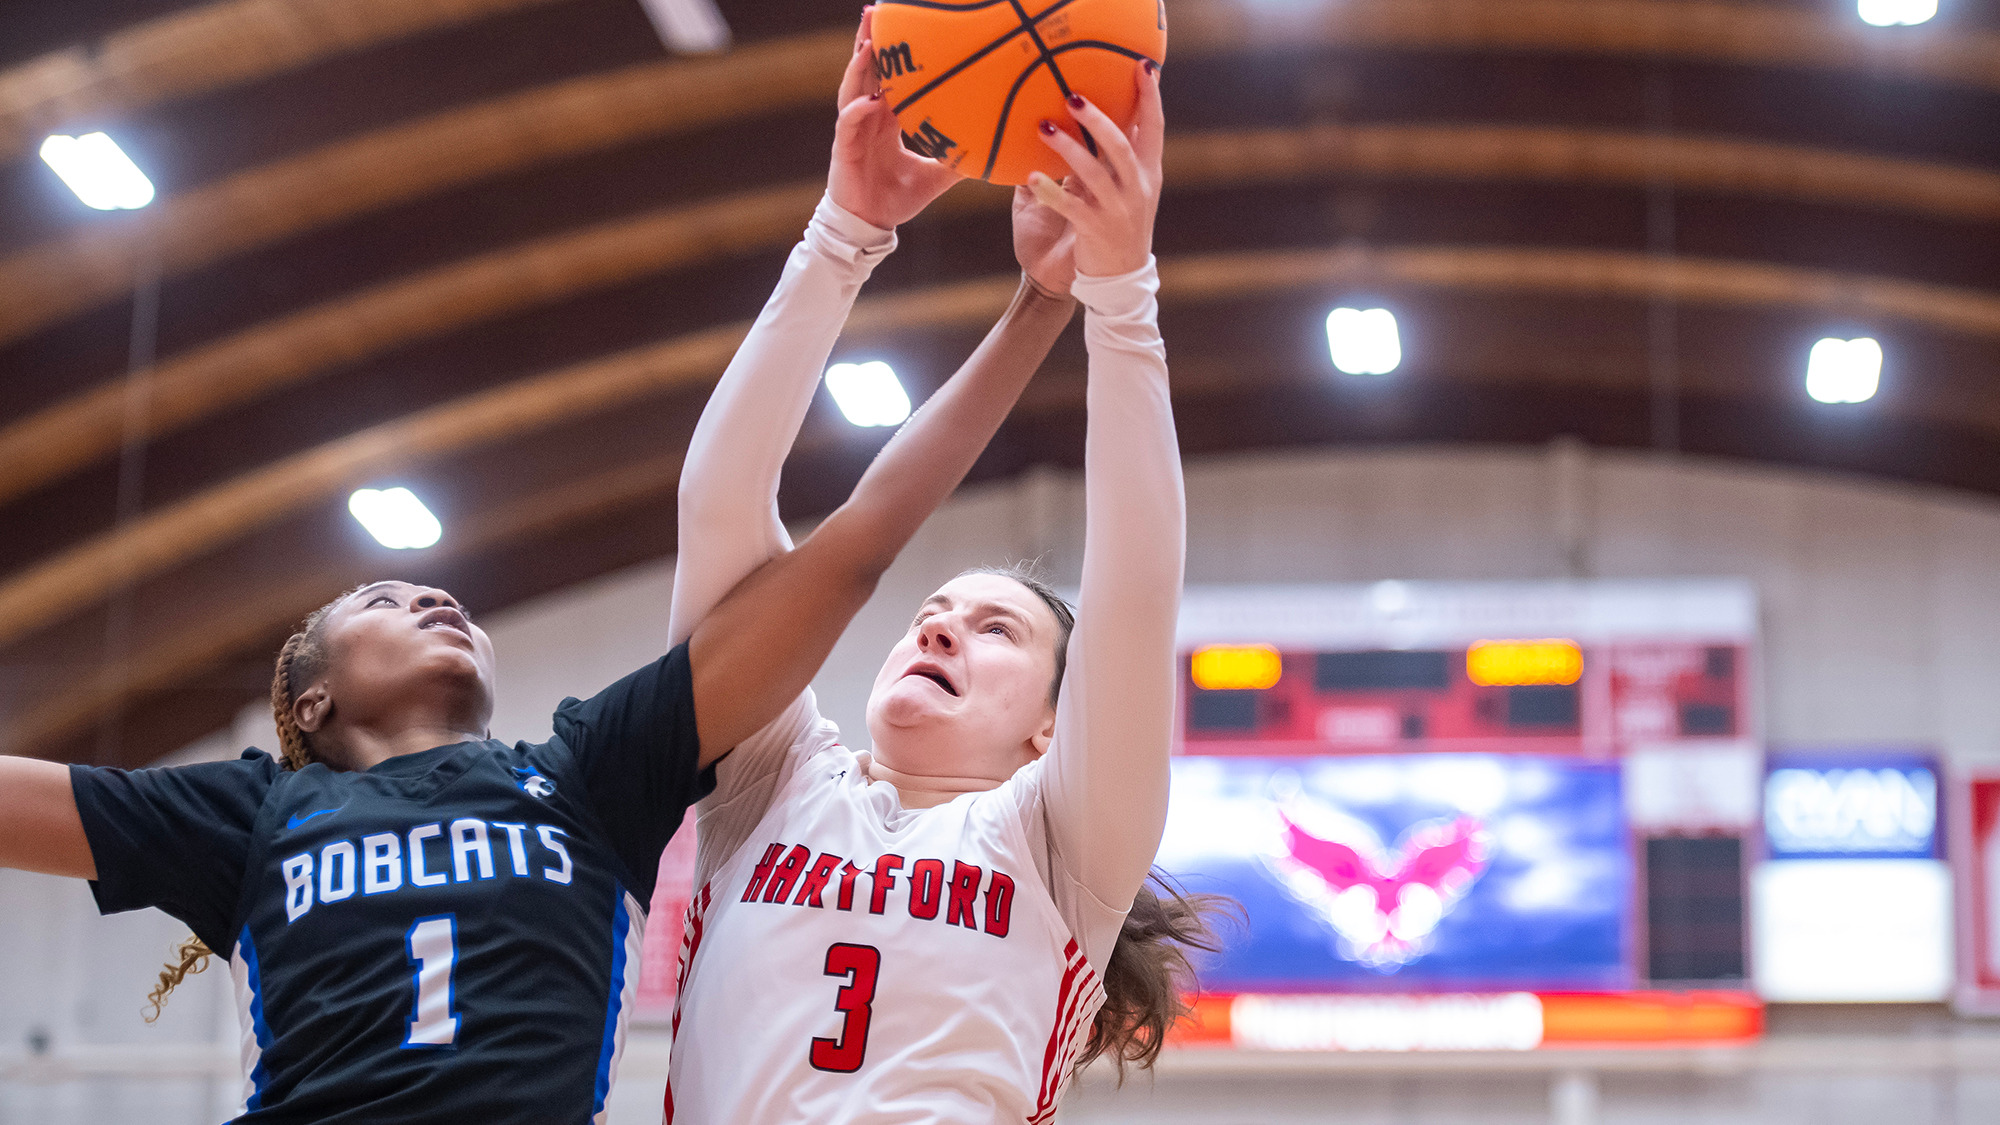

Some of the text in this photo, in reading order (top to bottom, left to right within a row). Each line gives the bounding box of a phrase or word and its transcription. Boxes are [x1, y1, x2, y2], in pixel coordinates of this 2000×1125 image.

[282, 817, 573, 924] BOBCATS
[740, 842, 1016, 939] HARTFORD
[401, 912, 462, 1050] 1
[809, 941, 881, 1074] 3
